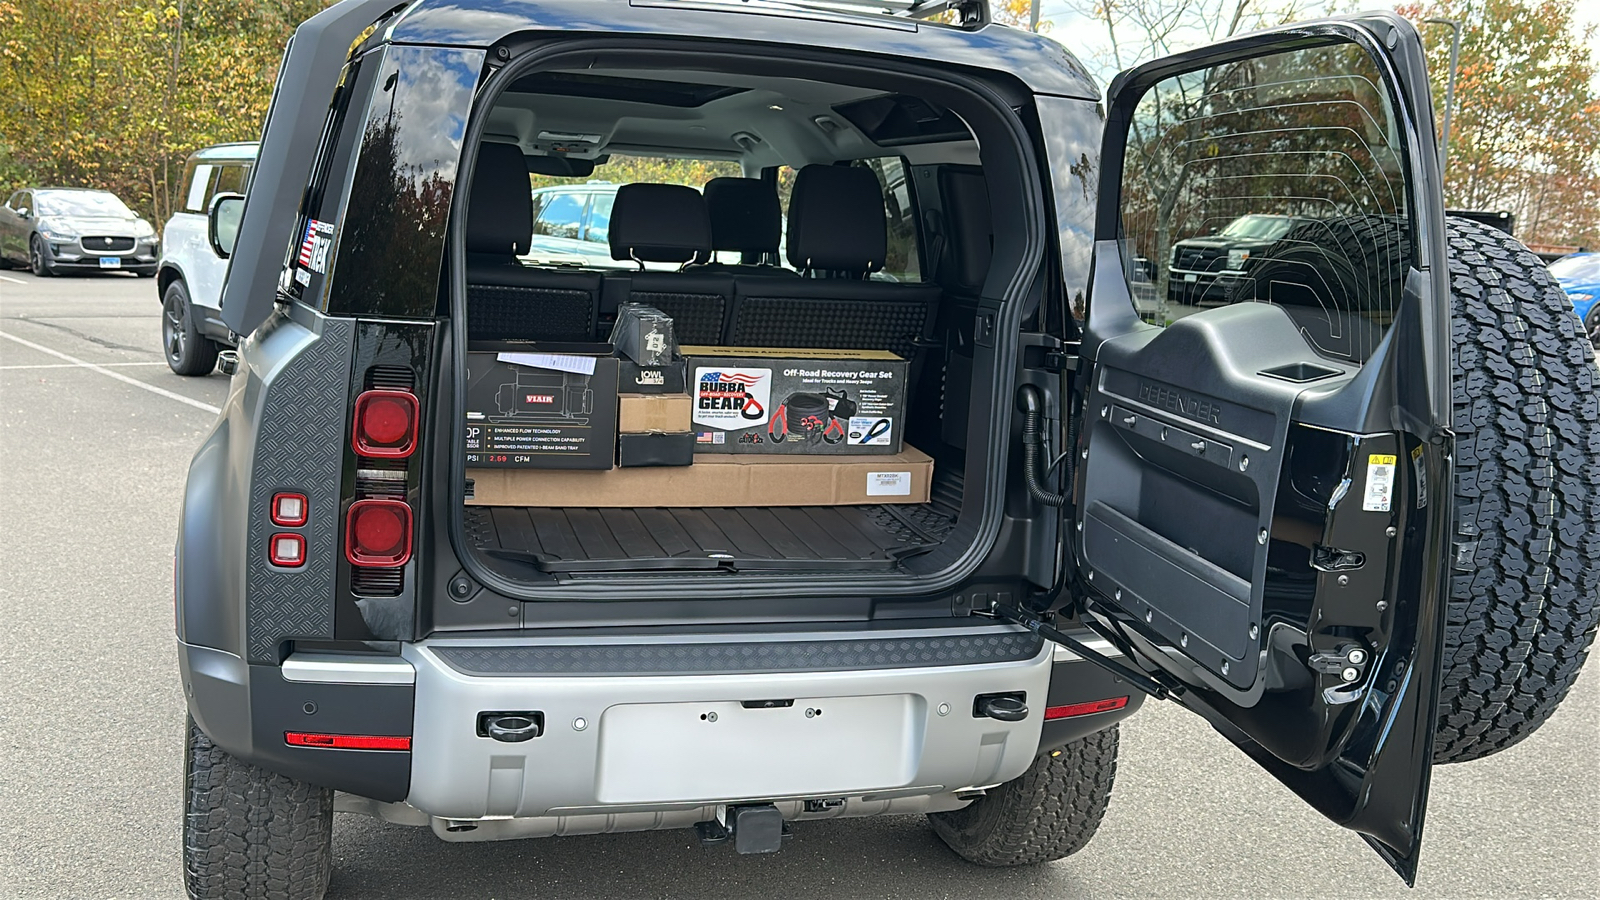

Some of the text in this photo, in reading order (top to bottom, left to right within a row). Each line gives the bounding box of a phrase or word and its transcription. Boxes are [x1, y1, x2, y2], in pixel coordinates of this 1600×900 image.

[635, 370, 665, 384] JOWL
[783, 369, 820, 377] Off-Road
[821, 370, 858, 379] Recovery
[879, 371, 893, 379] Set
[700, 382, 746, 392] BUBBA
[526, 395, 553, 403] VIAIR
[698, 397, 745, 410] GEAR
[1138, 382, 1222, 425] DEFENDER
